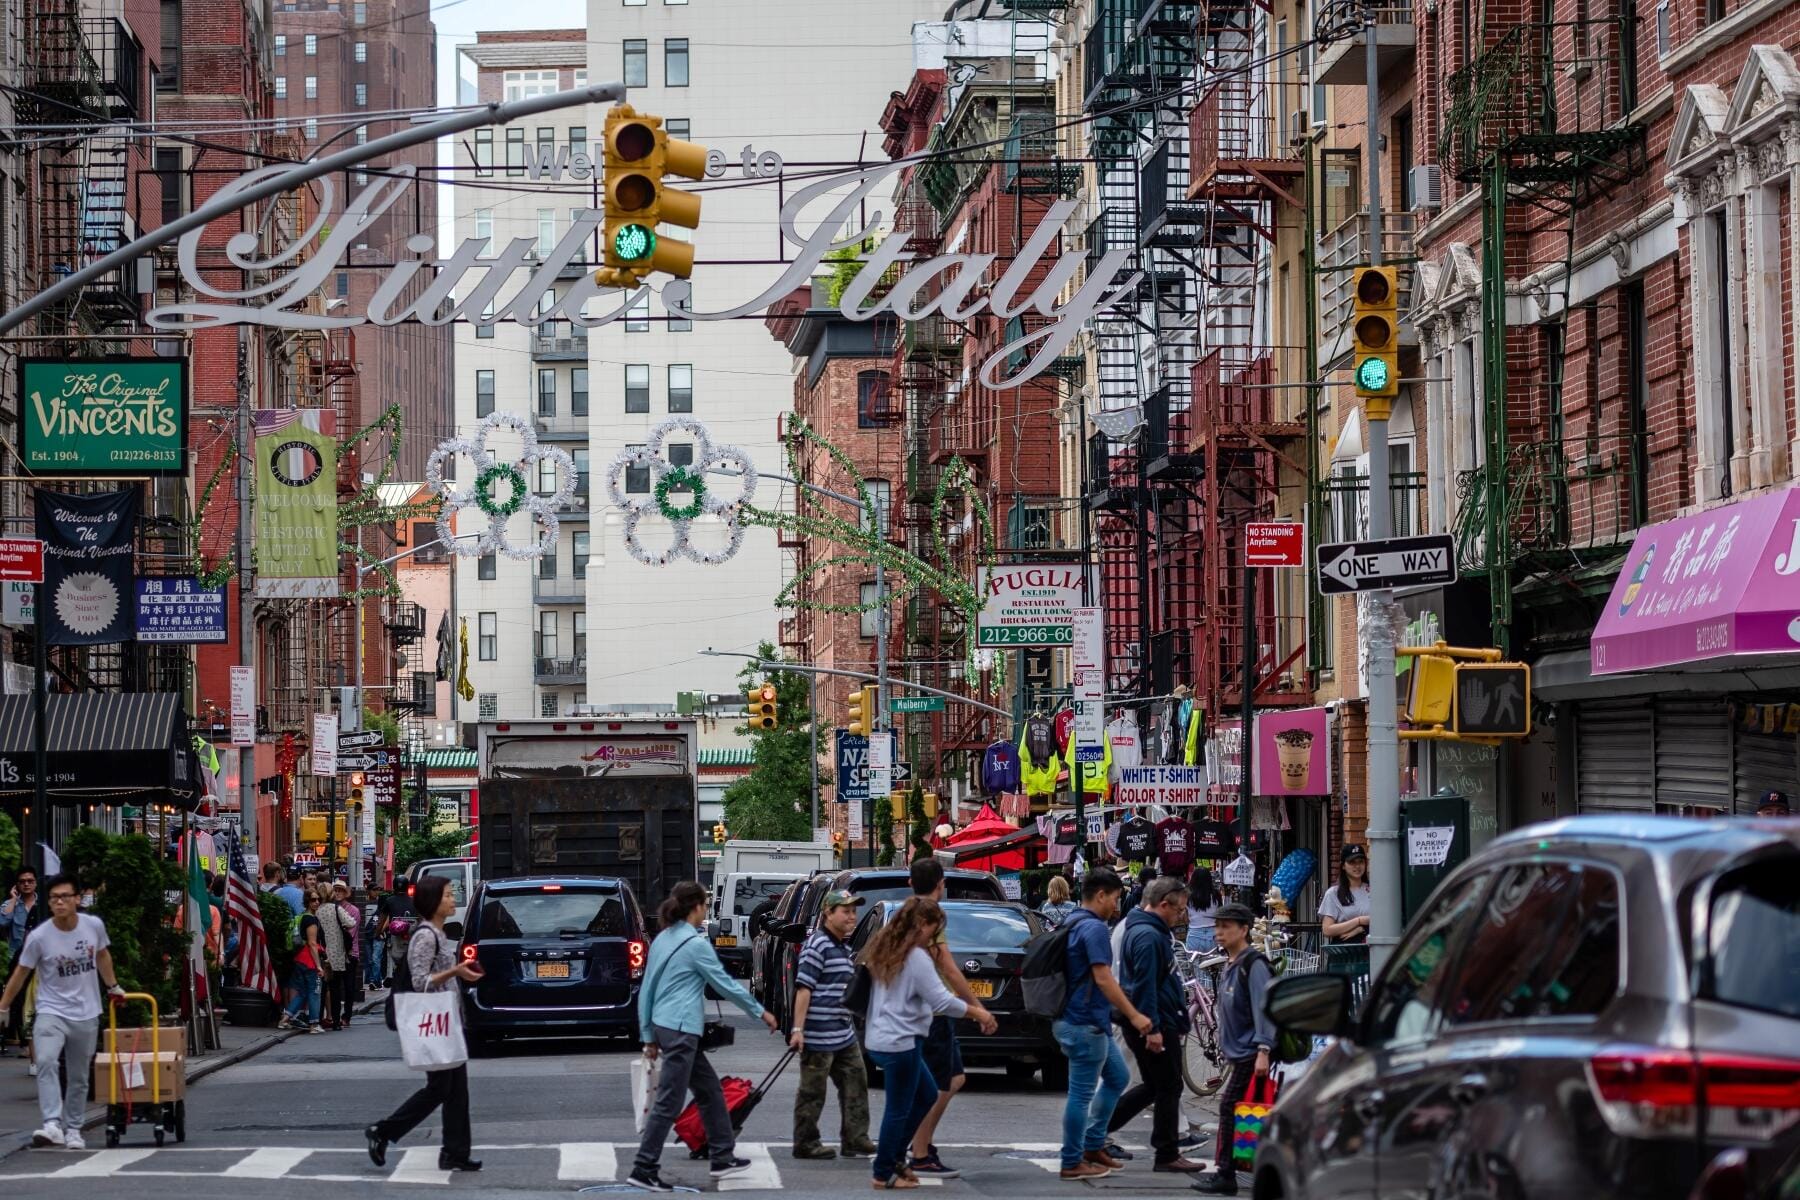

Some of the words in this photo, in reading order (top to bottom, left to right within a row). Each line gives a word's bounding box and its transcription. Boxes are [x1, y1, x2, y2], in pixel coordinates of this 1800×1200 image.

[524, 143, 726, 181] Wele
[740, 144, 783, 178] to
[145, 163, 653, 329] Little
[661, 149, 1144, 390] Italy
[62, 373, 98, 397] The
[101, 373, 170, 408] Original
[32, 451, 51, 461] Est.
[54, 451, 79, 461] 1904
[110, 450, 176, 462] (212)226-8133
[259, 494, 332, 507] WELCOME
[53, 508, 103, 522] Welcome
[107, 510, 118, 521] to
[261, 511, 278, 524] TO
[76, 526, 98, 541] The
[262, 526, 328, 539] HISTORIC
[1250, 527, 1260, 537] NO
[1261, 527, 1294, 537] STANDING
[0, 543, 8, 552] NO
[9, 544, 37, 553] STANDING
[1250, 537, 1277, 548] Anytime
[42, 541, 87, 559] Original
[88, 543, 132, 558] Vincents
[262, 543, 311, 556] LITTLE
[0, 553, 24, 564] Anytime
[1338, 556, 1380, 577] ONE
[1402, 550, 1442, 572] WAY
[262, 560, 304, 573] ITALY
[990, 569, 1089, 597] PUGLIA
[67, 592, 108, 601] Business
[75, 603, 100, 612] Since
[1012, 599, 1066, 607] RESTAURANT
[189, 605, 221, 614] LIP-INK
[1001, 608, 1041, 616] COCKTAIL
[1044, 608, 1072, 616] LOUNG
[1000, 616, 1052, 624] BRICK-OVEN
[1054, 616, 1073, 624] PIZZ
[985, 627, 1073, 643] 212-966-60
[1595, 644, 1607, 667] 121
[897, 700, 928, 710] Mulberry
[341, 737, 355, 745] ONE
[362, 735, 377, 743] WAY
[616, 744, 676, 756] VAN-LINES
[992, 760, 1011, 772] NY
[25, 773, 51, 782] Sie
[54, 773, 76, 782] 1904
[367, 774, 394, 782] Foot
[1122, 768, 1156, 784] WHITE
[1159, 768, 1201, 784] T-SHIRT
[374, 786, 396, 794] ack
[1120, 787, 1156, 803] COLOR
[1158, 787, 1201, 803] T-SHIRT
[374, 794, 393, 802] ub
[1426, 831, 1438, 839] NO
[1415, 839, 1449, 847] PARKING
[57, 961, 96, 978] RECITAL
